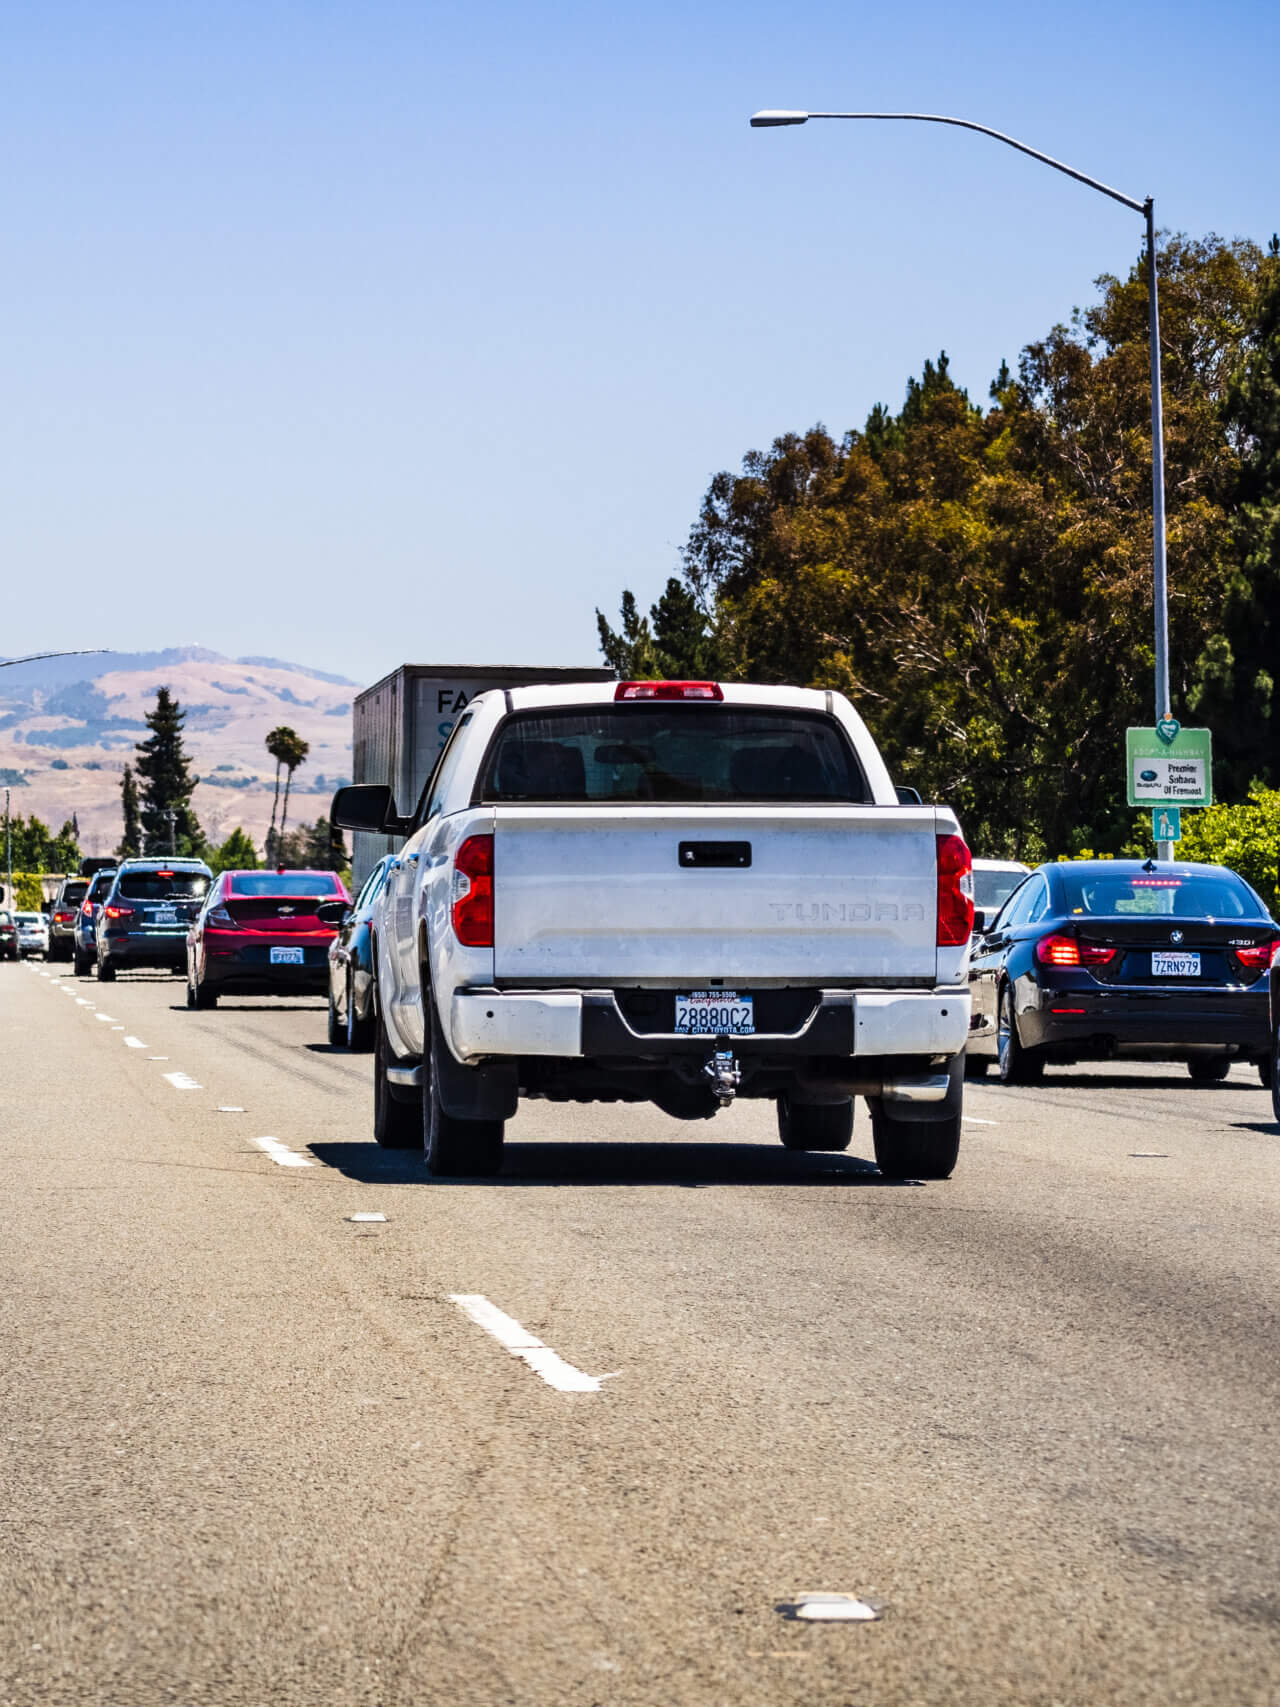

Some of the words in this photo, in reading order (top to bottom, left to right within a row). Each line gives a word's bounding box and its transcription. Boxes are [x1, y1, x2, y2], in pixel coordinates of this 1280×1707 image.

[769, 903, 924, 921] TUNDRA
[1154, 961, 1199, 973] 7ZRN979
[679, 1007, 750, 1027] 28880C2
